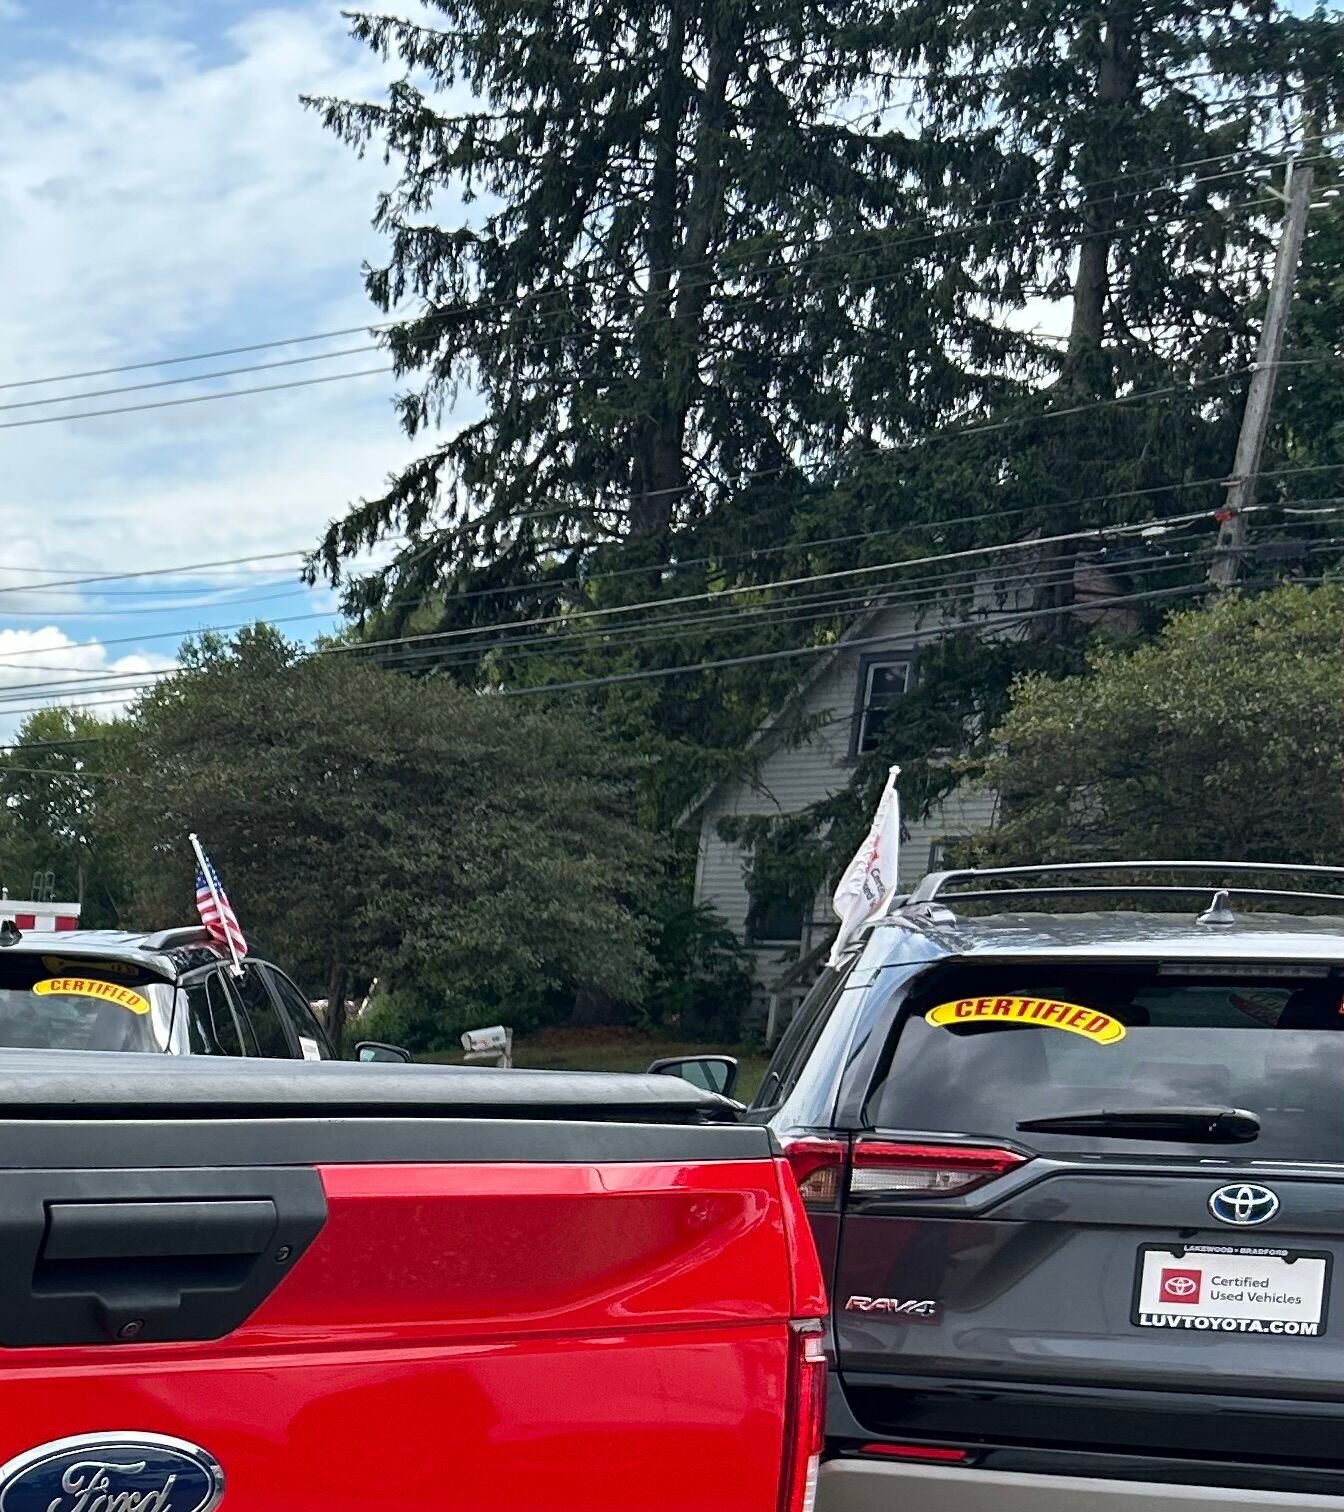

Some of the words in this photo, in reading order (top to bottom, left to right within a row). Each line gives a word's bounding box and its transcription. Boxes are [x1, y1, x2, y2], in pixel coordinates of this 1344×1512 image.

[50, 979, 141, 1006] CERTIFIED
[955, 998, 1110, 1033] CERTIFIED
[1184, 1244, 1233, 1254] LAKEWOOD
[1240, 1247, 1289, 1257] BRADFORD
[1211, 1275, 1270, 1289] Certified
[845, 1295, 936, 1317] RAV4
[1210, 1290, 1244, 1302] Used
[1247, 1291, 1302, 1305] Vehicles
[1140, 1313, 1319, 1336] LUVTOYOTA.COM
